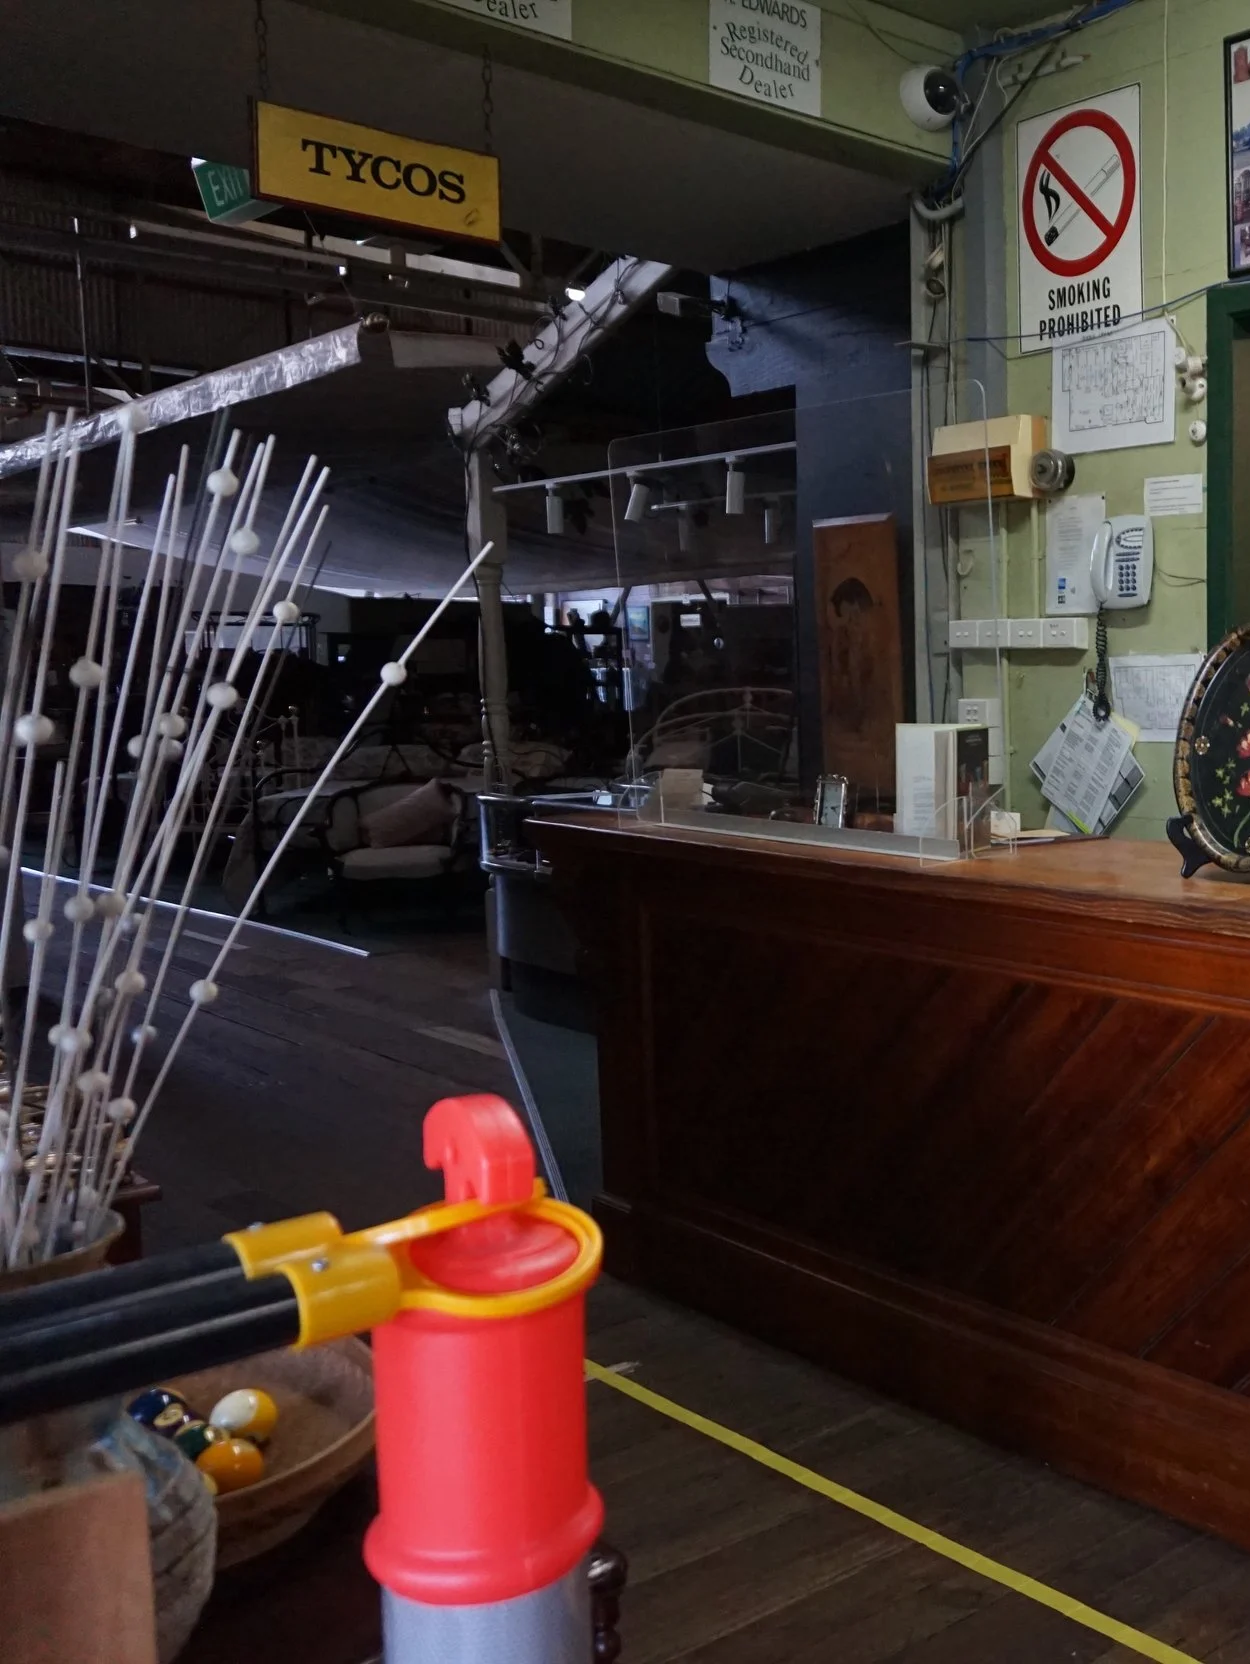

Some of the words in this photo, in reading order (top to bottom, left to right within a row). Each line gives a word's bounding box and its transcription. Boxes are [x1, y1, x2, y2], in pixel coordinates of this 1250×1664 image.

[475, 0, 539, 19] ealer
[720, 35, 810, 82] Secondhand
[725, 21, 809, 65] Registered
[738, 64, 795, 99] Dealer
[301, 138, 467, 204] TYCOS
[1047, 276, 1111, 311] SMOKING
[1039, 304, 1121, 341] PROHIBITED
